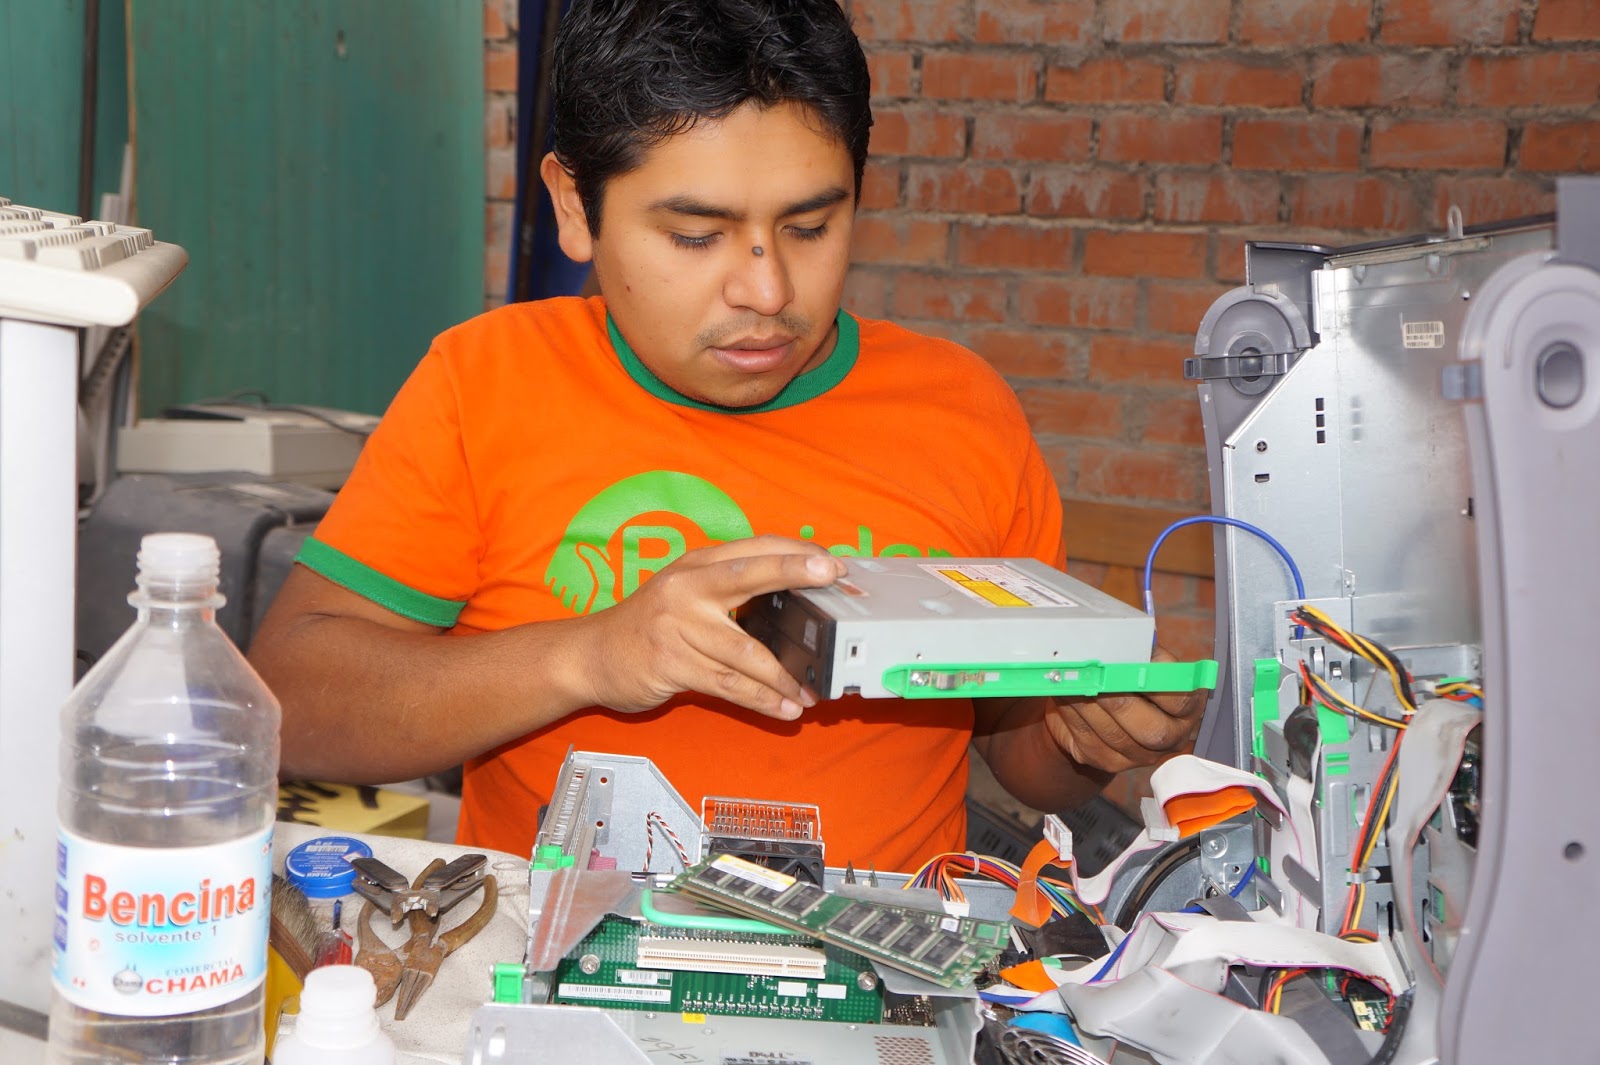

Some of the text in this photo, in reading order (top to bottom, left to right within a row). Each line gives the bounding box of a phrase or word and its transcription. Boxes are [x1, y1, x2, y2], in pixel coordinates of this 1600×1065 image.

[83, 873, 256, 926] Bencina
[115, 926, 201, 944] solvente
[145, 963, 244, 994] CHAMA
[165, 957, 234, 976] COMERCIAL
